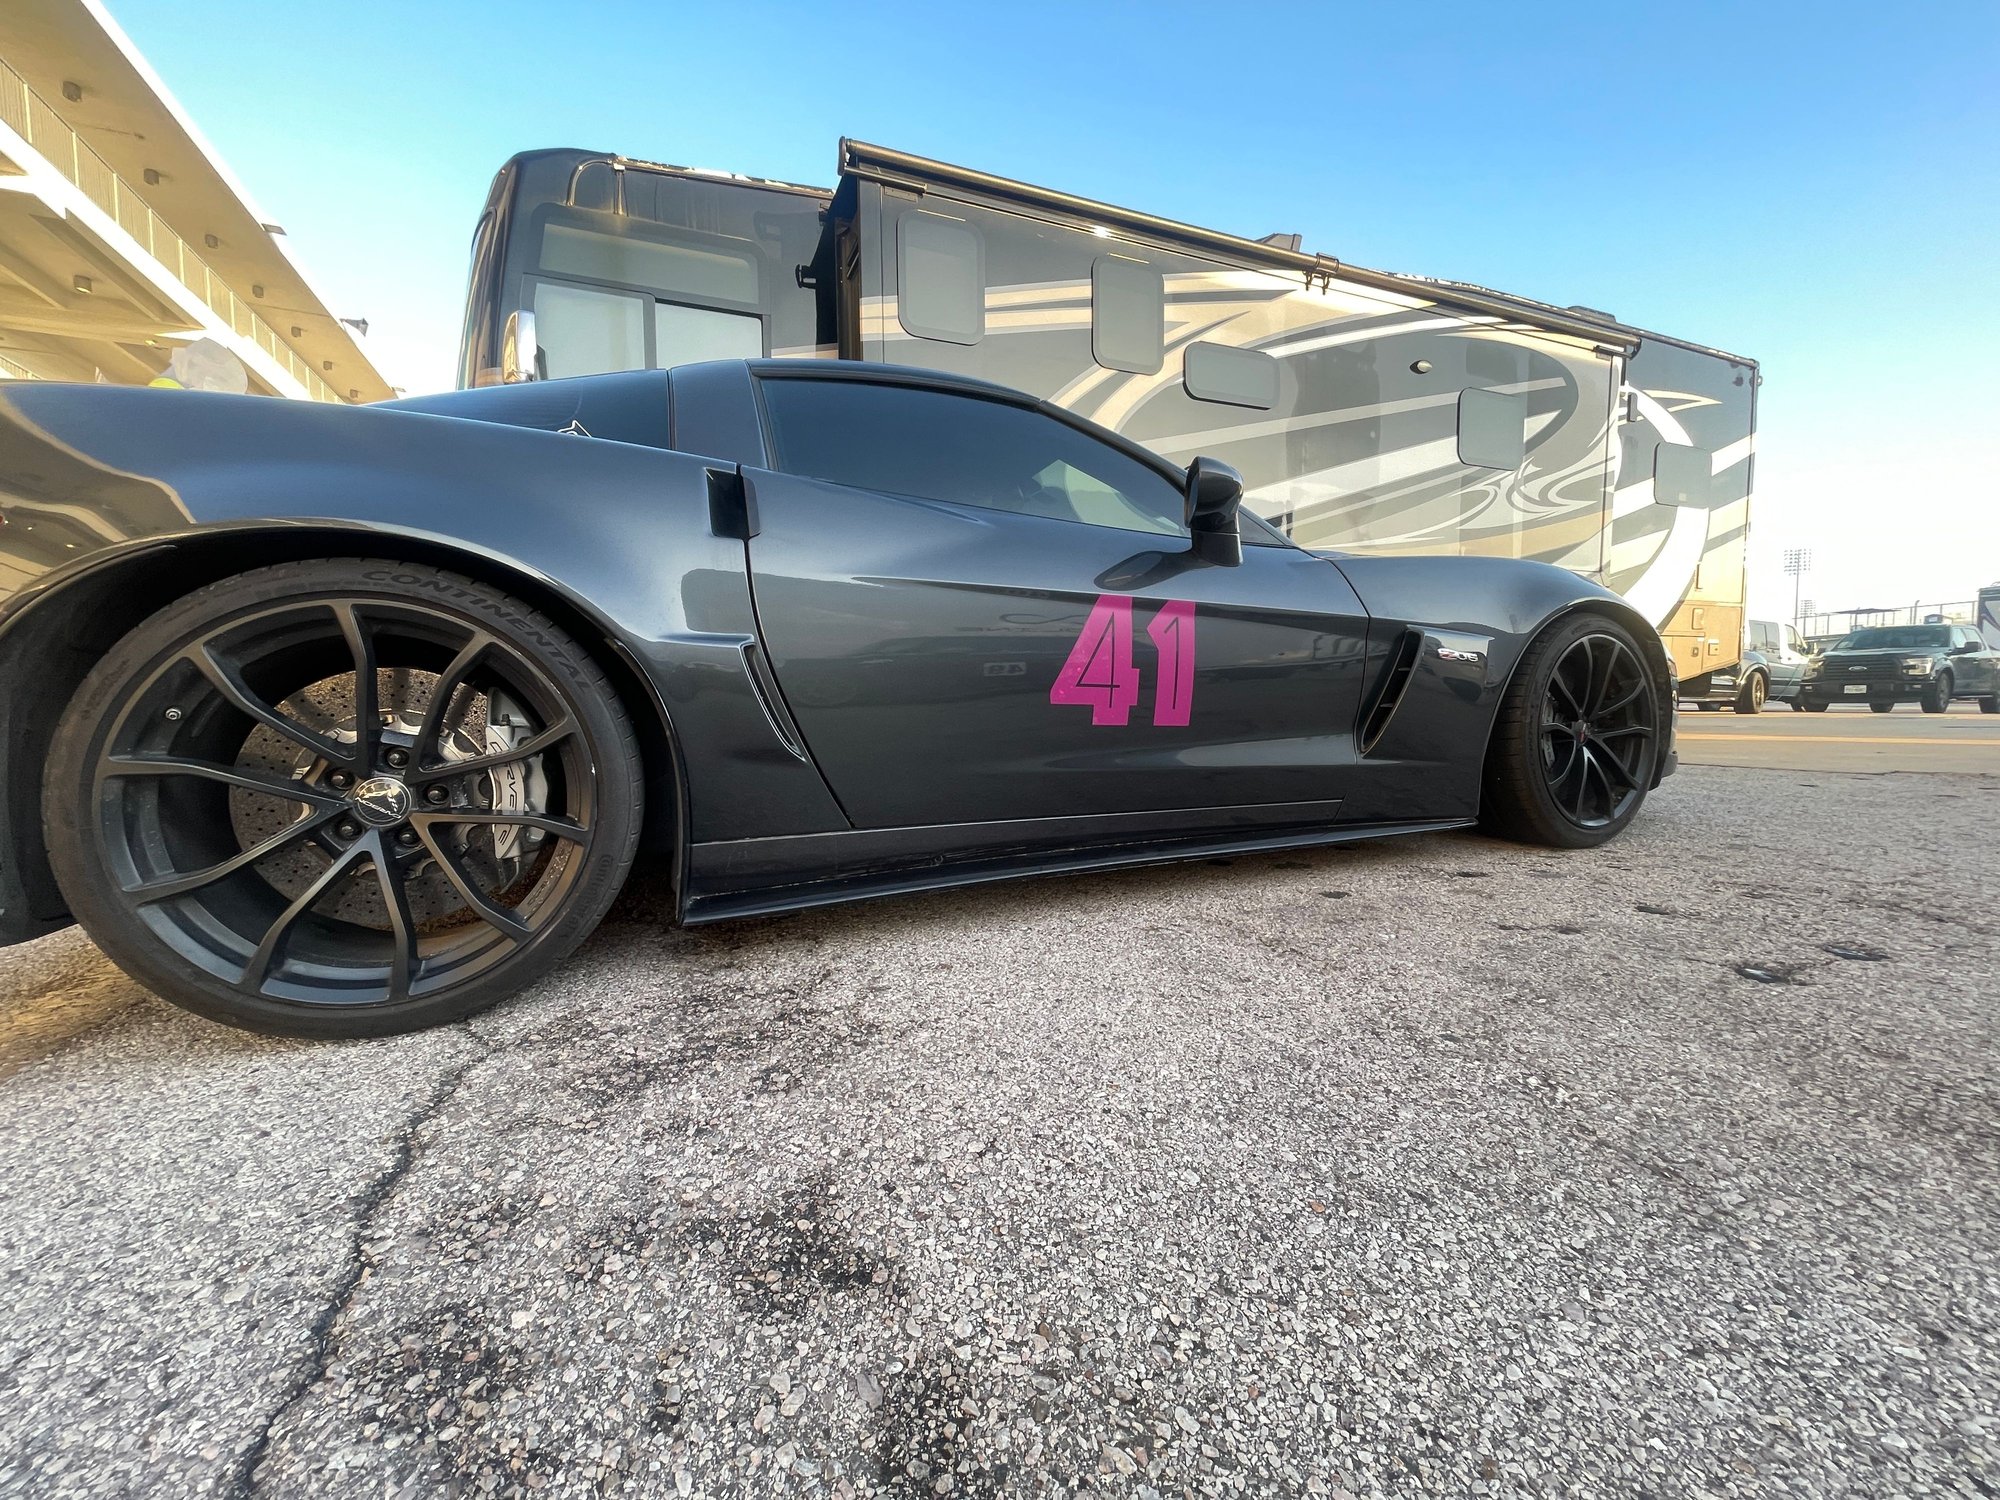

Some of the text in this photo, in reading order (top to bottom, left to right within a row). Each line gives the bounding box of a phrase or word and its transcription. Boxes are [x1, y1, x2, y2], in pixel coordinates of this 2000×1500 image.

[362, 570, 594, 692] CONTINENTAL
[1050, 594, 1196, 726] 41
[489, 741, 518, 846] CRVEE
